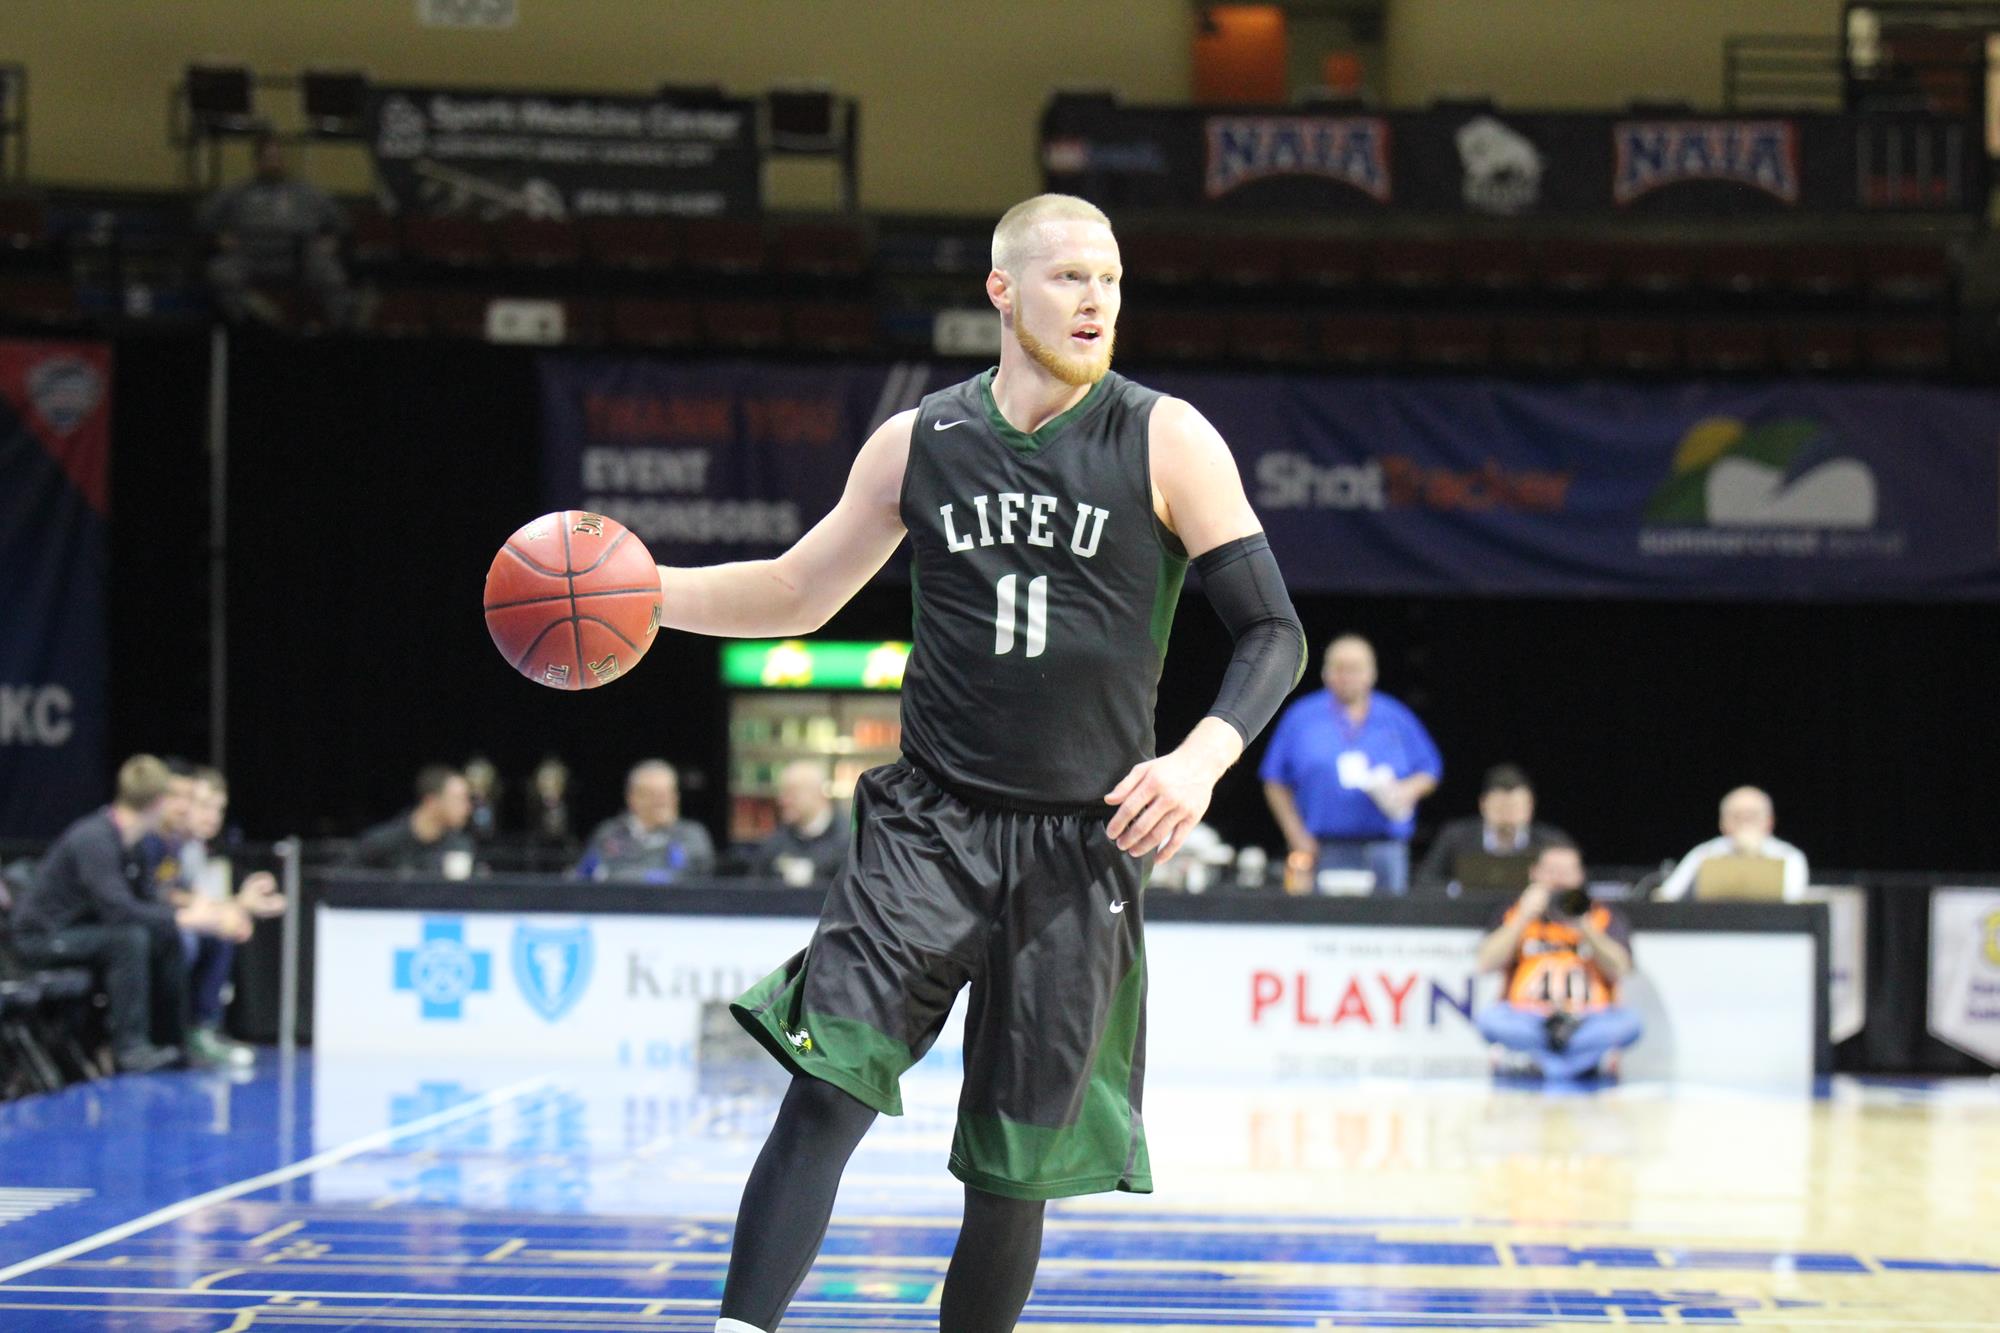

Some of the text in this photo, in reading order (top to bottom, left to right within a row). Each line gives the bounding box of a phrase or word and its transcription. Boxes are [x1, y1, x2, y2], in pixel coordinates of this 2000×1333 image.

[1209, 117, 1389, 200] NAIA
[1617, 121, 1798, 202] NAIA
[582, 449, 709, 492] EVENT
[940, 493, 1110, 558] LIFE U
[995, 574, 1048, 658] 11
[626, 951, 762, 1000] Kan
[1251, 971, 1475, 1026] PLAYN
